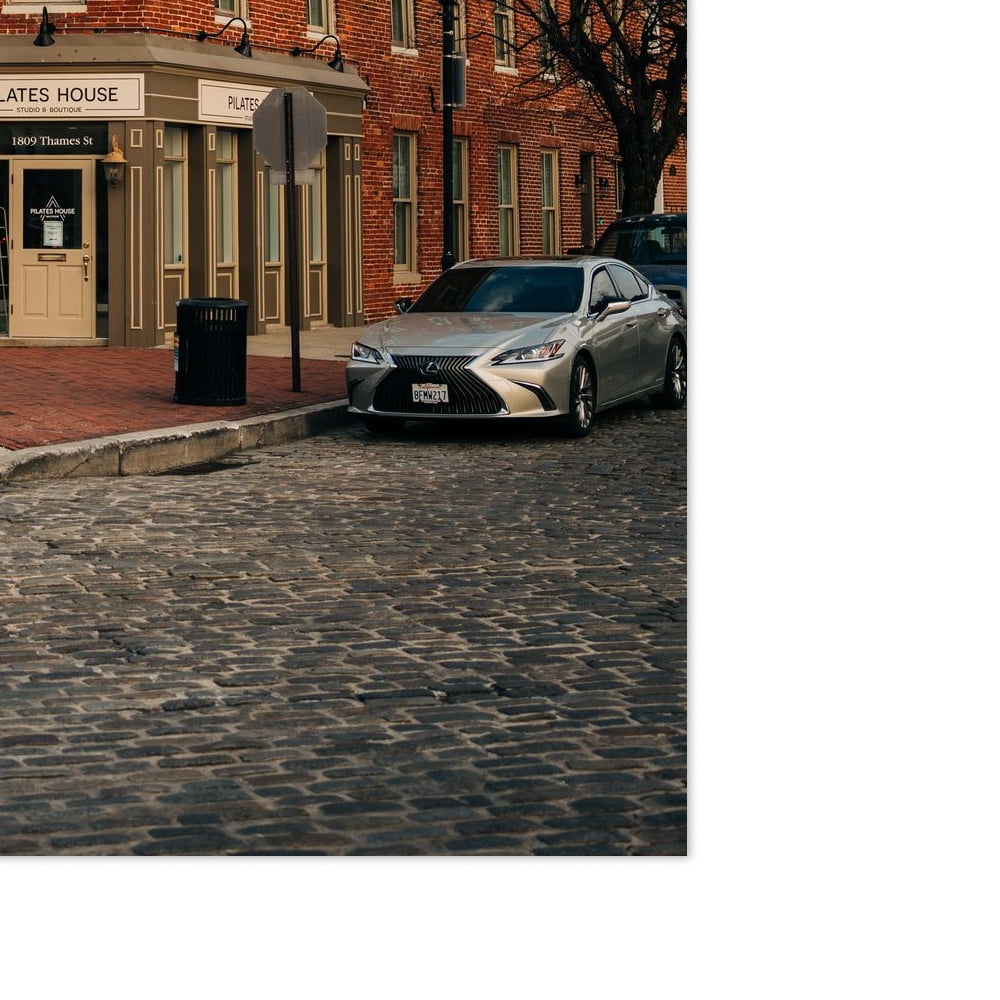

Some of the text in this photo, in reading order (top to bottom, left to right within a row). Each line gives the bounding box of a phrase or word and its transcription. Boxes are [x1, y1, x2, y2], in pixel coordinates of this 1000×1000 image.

[57, 87, 118, 101] HOUSE
[228, 96, 259, 111] PILATES
[11, 136, 93, 146] 1809 Thames St
